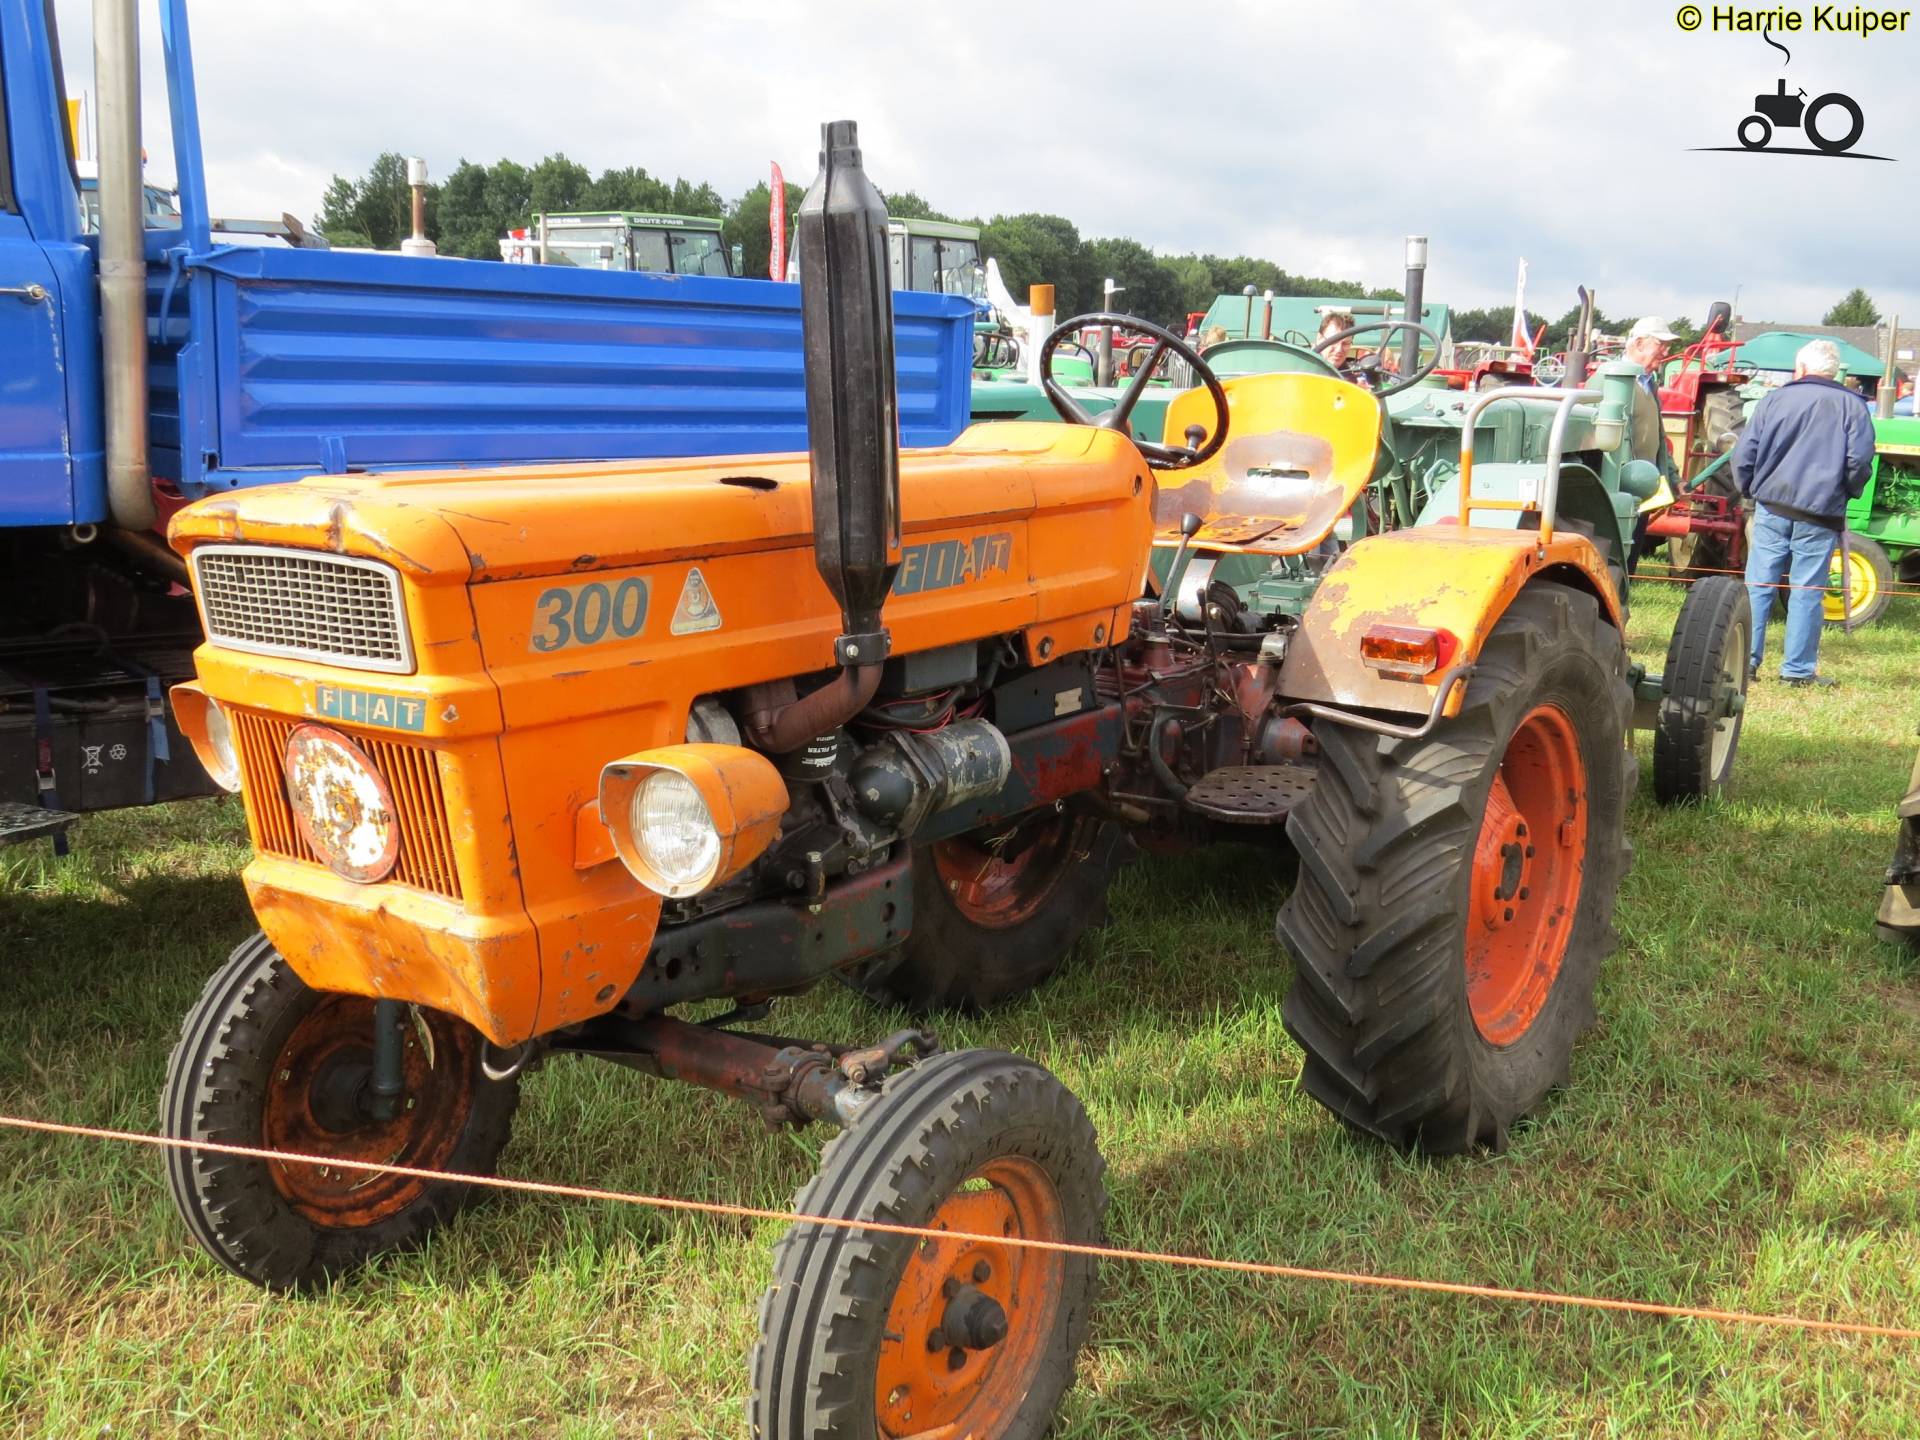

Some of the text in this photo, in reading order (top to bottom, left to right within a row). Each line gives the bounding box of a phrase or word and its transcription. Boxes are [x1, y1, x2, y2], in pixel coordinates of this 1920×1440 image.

[633, 217, 684, 226] DEUTZ-FAHR
[900, 539, 1008, 588] FIAT
[532, 576, 648, 651] 300
[321, 689, 420, 725] FIAT
